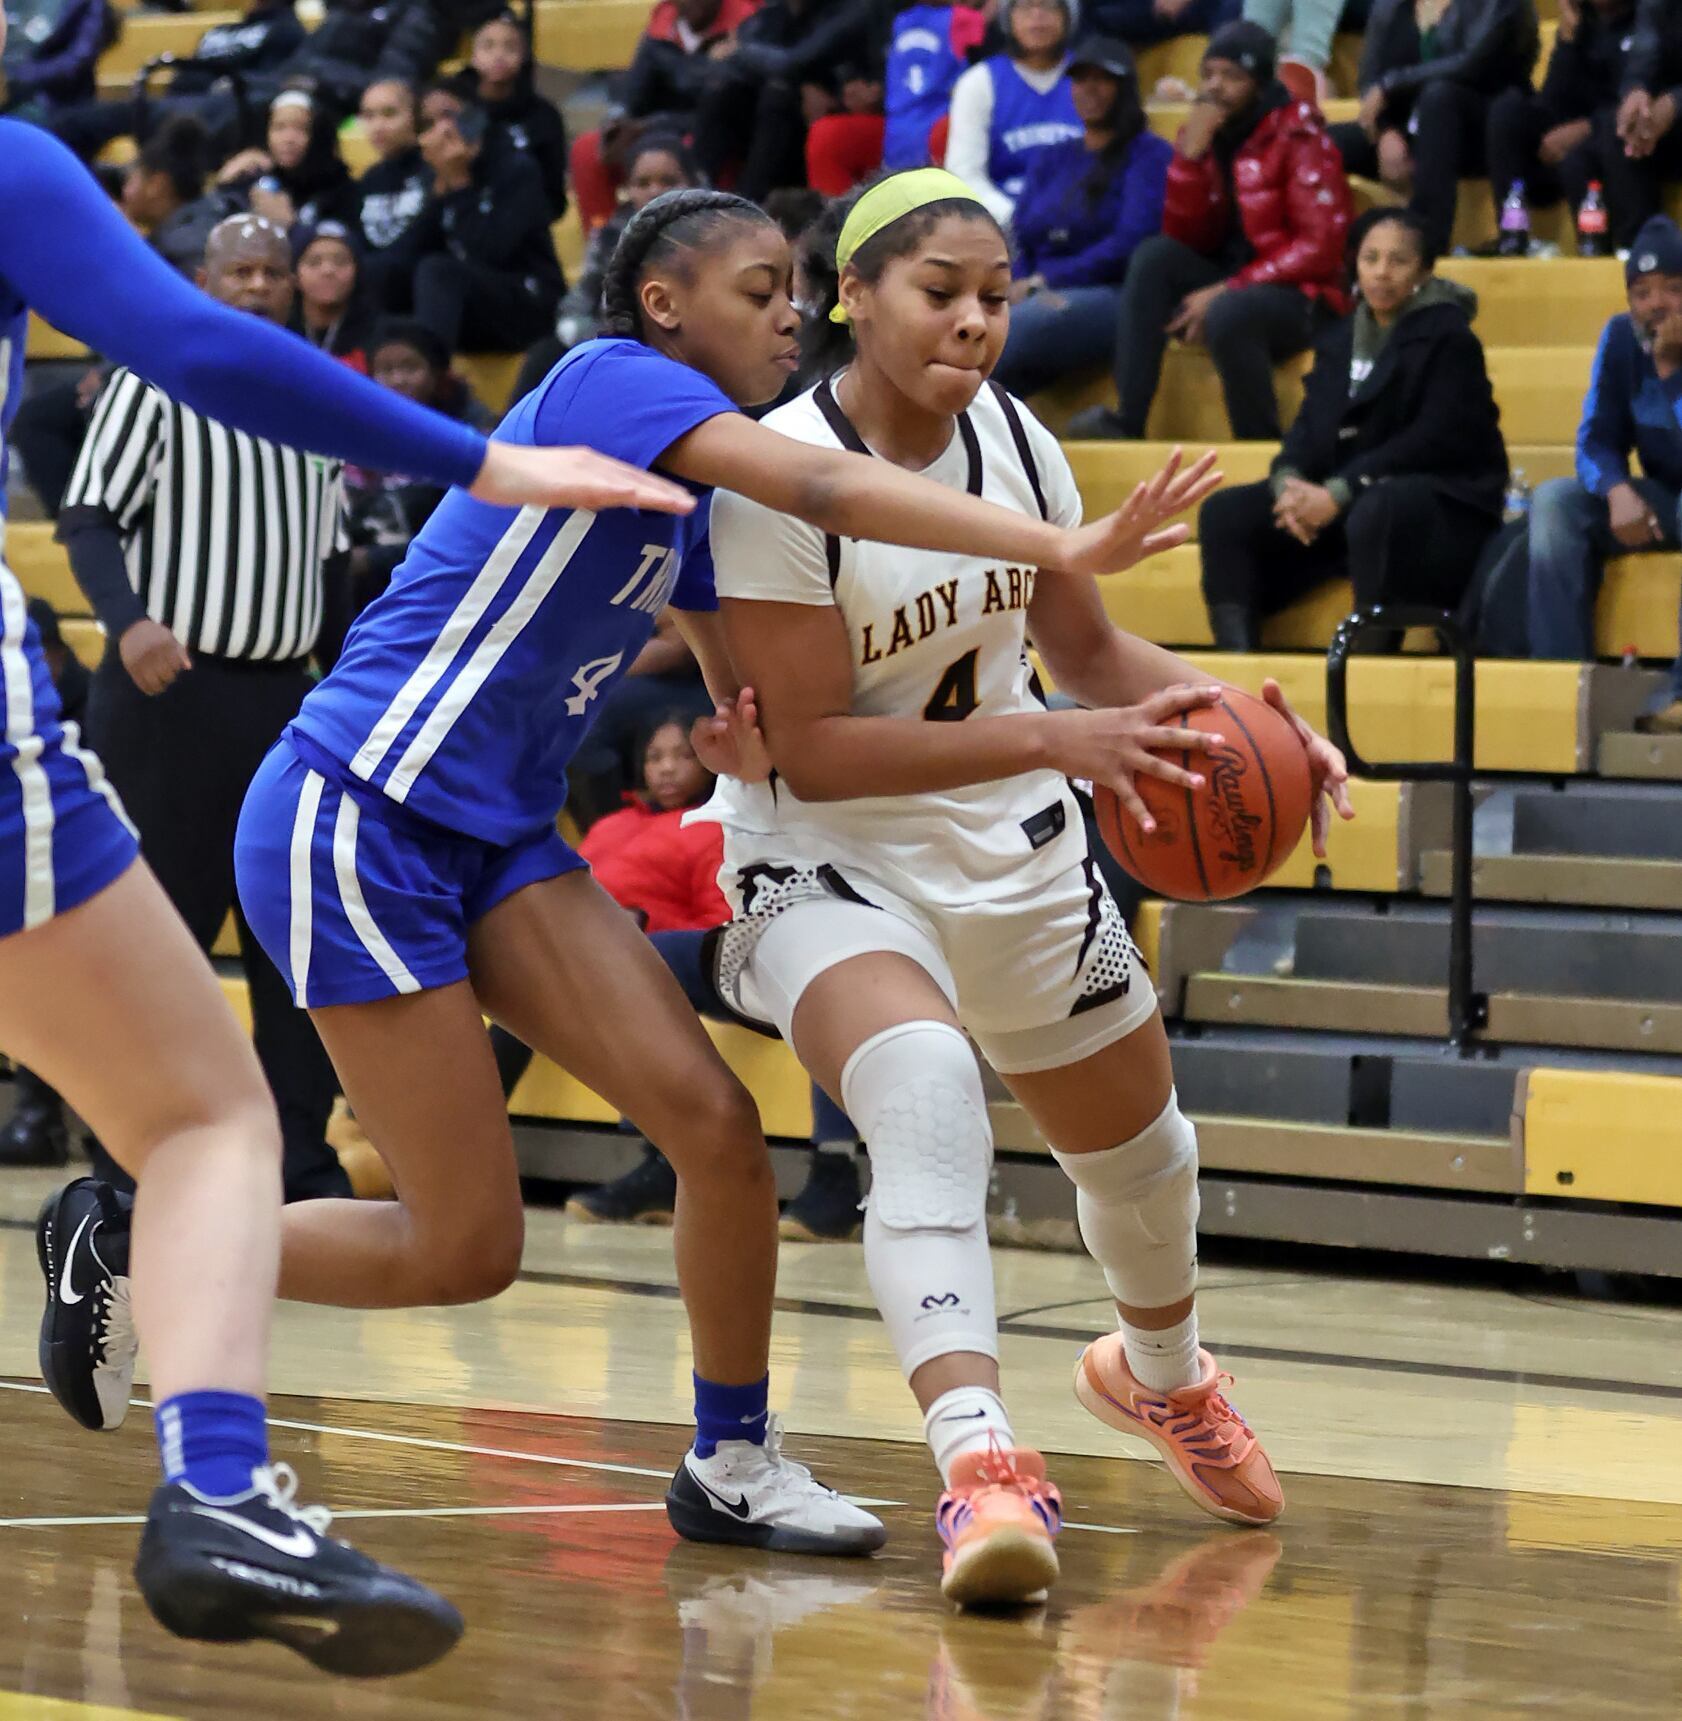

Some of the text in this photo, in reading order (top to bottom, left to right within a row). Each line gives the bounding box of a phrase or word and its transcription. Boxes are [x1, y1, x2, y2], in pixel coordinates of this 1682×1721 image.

[862, 577, 959, 666] LADY
[565, 649, 626, 717] 4
[922, 644, 984, 722] 4
[1206, 745, 1263, 873] Rawlings
